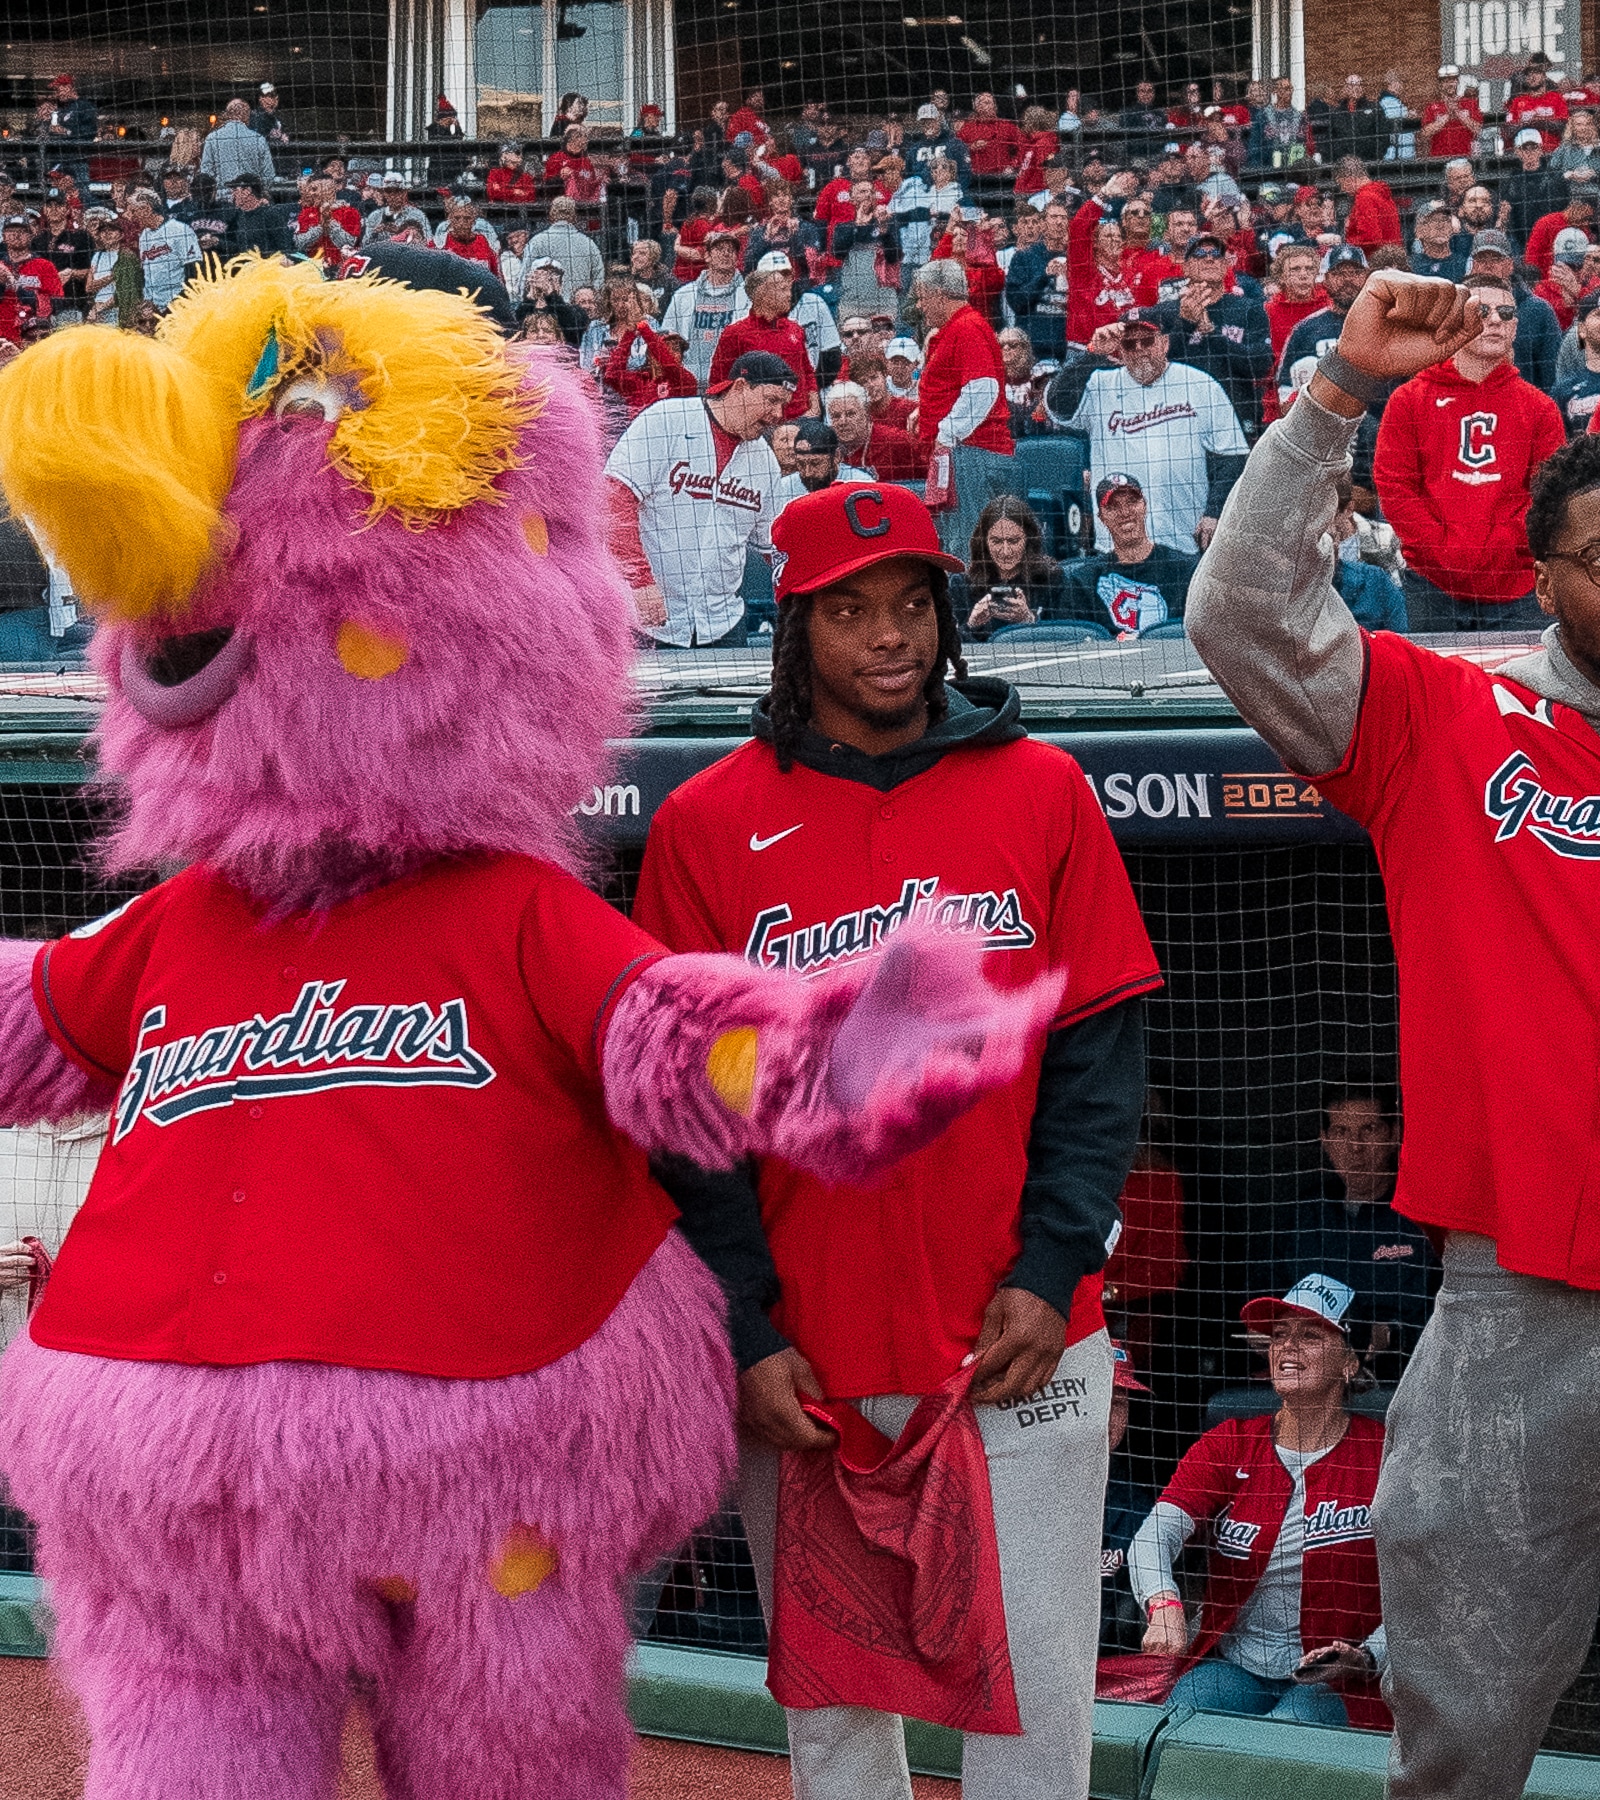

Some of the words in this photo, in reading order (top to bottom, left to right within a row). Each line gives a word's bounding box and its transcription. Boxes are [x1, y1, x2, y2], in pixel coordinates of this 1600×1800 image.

[1454, 0, 1566, 66] HOME
[1108, 402, 1197, 436] Guardians
[1458, 410, 1498, 468] C
[669, 460, 762, 513] Guardians
[844, 489, 891, 538] C
[1222, 784, 1323, 808] 2024
[1016, 1399, 1089, 1429] DEPT.
